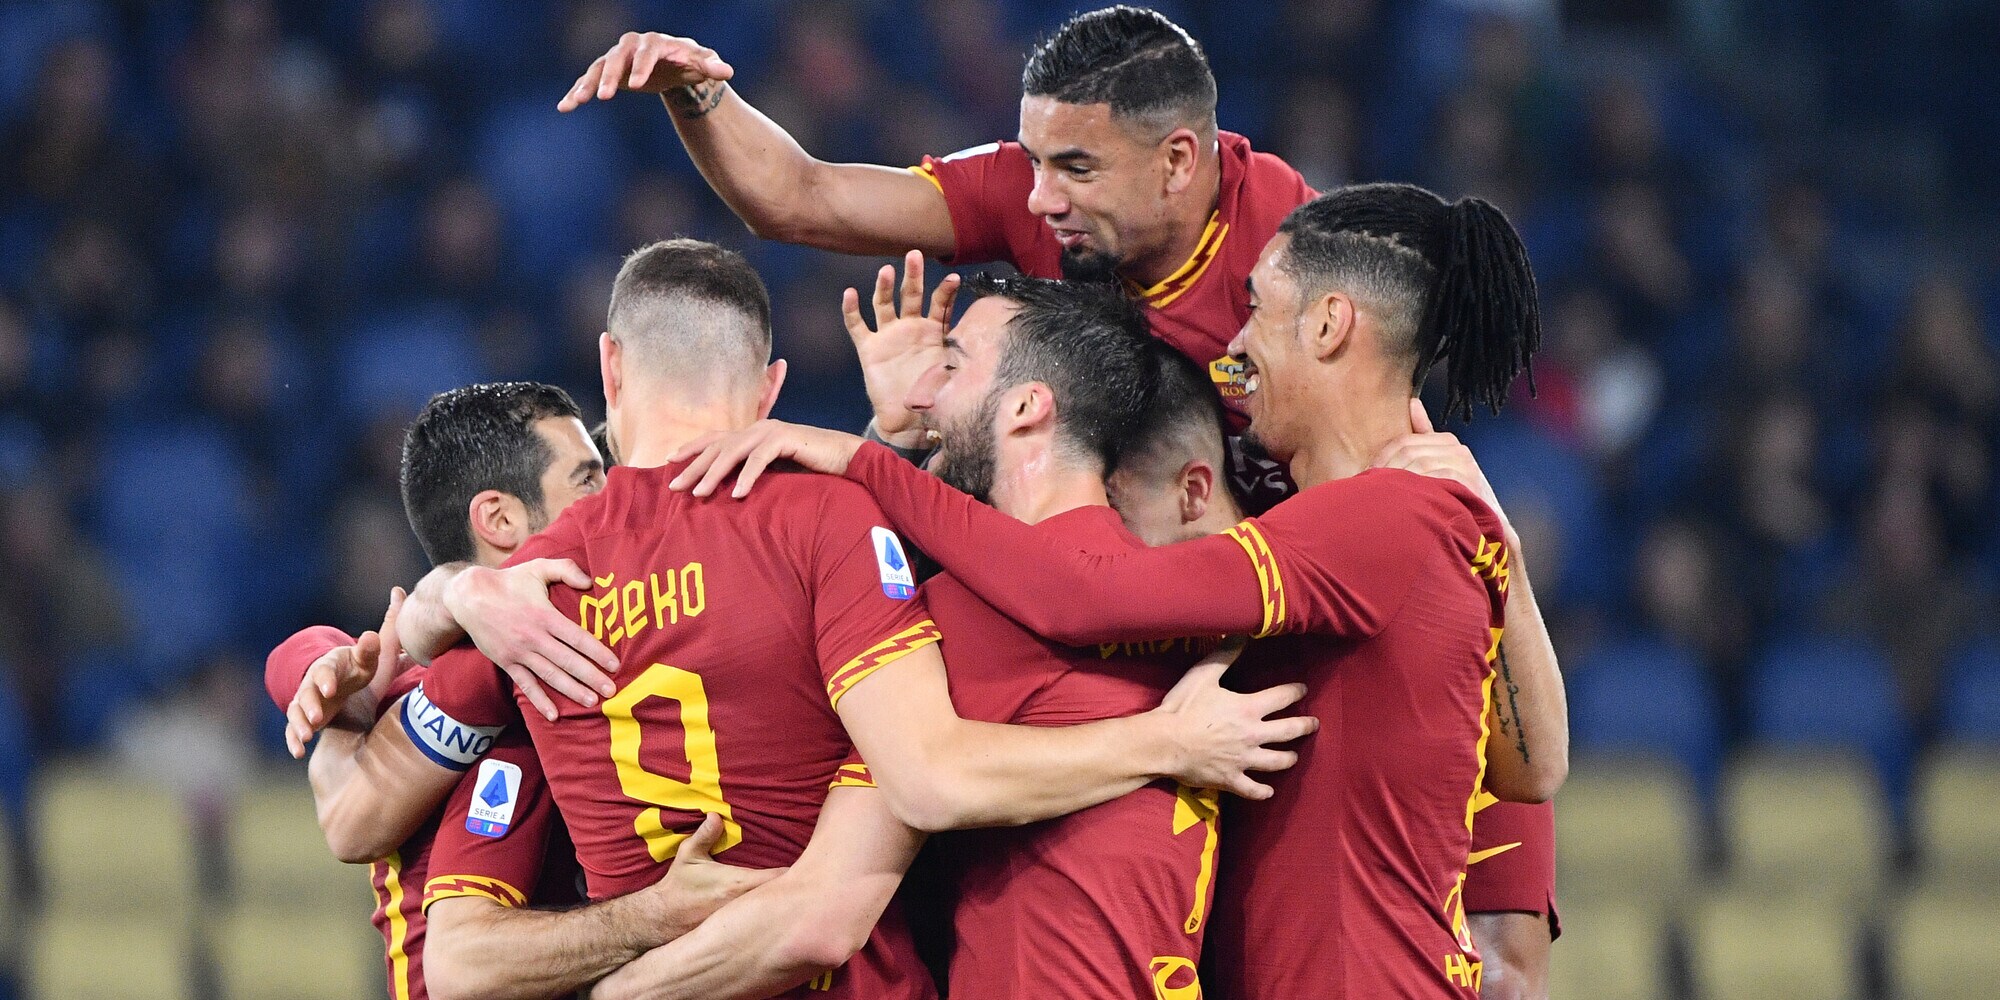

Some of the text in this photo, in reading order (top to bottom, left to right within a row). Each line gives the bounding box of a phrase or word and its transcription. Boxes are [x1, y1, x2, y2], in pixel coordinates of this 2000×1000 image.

[886, 573, 904, 582] SERIE
[602, 662, 742, 863] 9
[474, 807, 498, 819] SERIE
